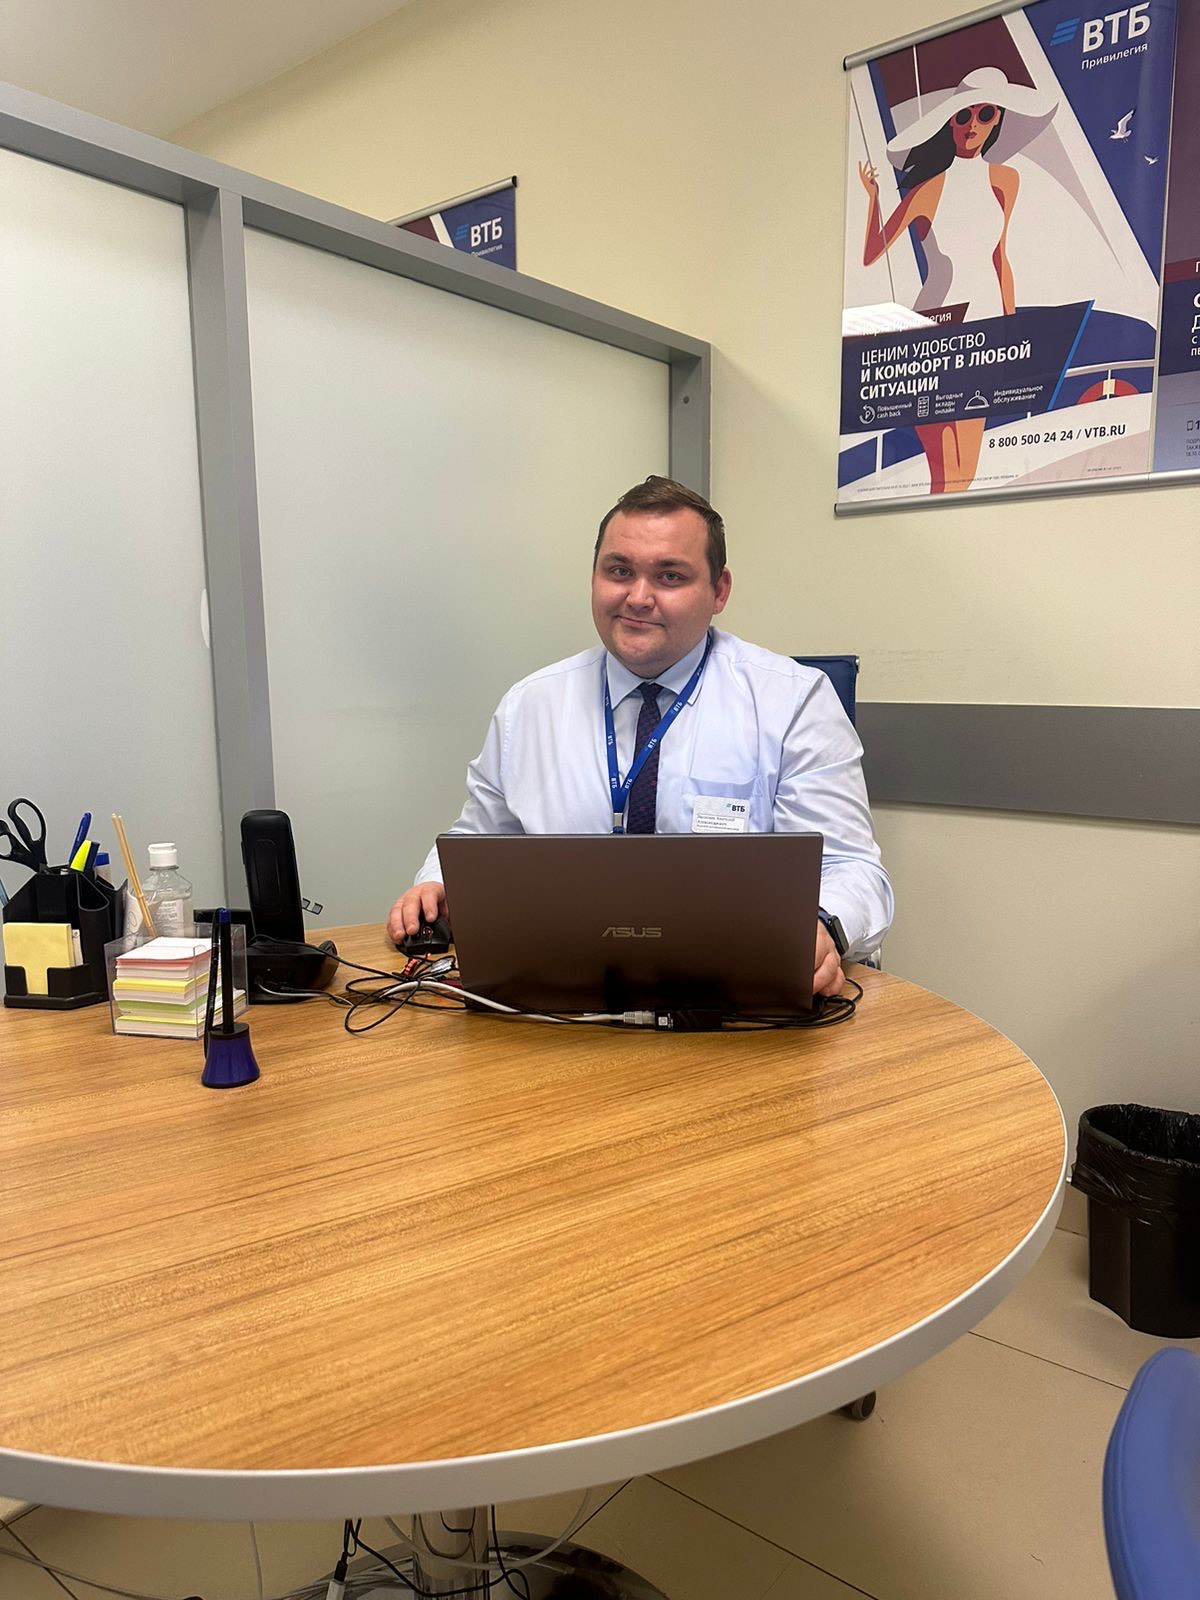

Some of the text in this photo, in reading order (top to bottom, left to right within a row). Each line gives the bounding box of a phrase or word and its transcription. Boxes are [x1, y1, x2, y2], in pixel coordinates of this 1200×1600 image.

[1083, 2, 1150, 53] ВТБ
[1081, 43, 1148, 70] Привилегия
[471, 217, 503, 247] ВТБ
[860, 340, 1031, 383] И КОМФОРТ В ЛЮБОЙ
[861, 332, 986, 367] ЦЕНИМ УДОБСТВО
[860, 376, 939, 400] СИТУАЦИИ
[988, 424, 1126, 449] 8 800 500 24 24 / VTB.RU
[602, 926, 662, 938] ASUS
